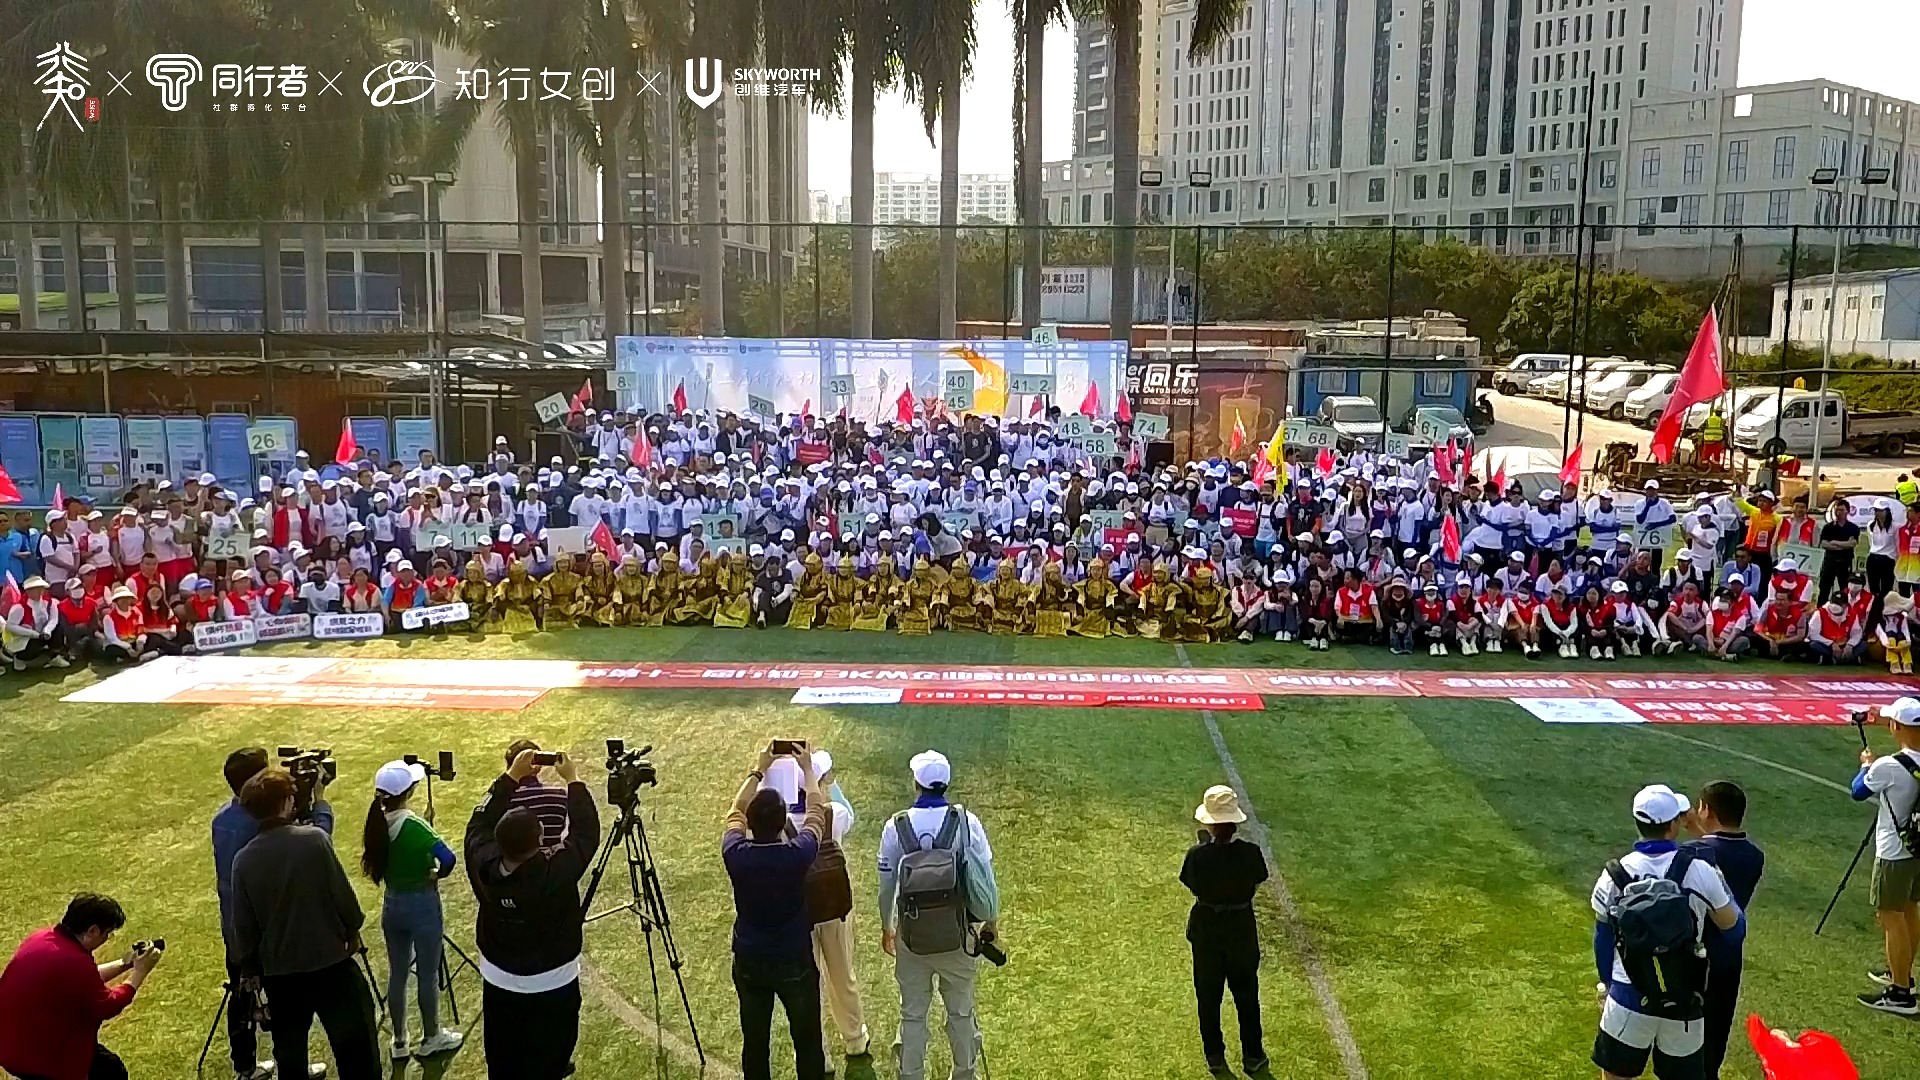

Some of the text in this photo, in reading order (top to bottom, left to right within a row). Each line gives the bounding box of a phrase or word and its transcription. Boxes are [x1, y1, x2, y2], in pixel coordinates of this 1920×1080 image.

[947, 375, 965, 388] 40
[1011, 379, 1027, 391] 41
[1040, 379, 1049, 392] 2
[948, 396, 966, 408] 45
[542, 401, 559, 418] 20
[1061, 421, 1081, 435] 48
[1137, 419, 1156, 434] 74
[252, 433, 275, 450] 26
[1308, 432, 1327, 445] 68
[1085, 439, 1104, 453] 58
[843, 520, 861, 533] 51
[1094, 517, 1112, 530] 54
[460, 531, 477, 546] 11
[1638, 530, 1660, 545] 76
[213, 539, 236, 556] 25
